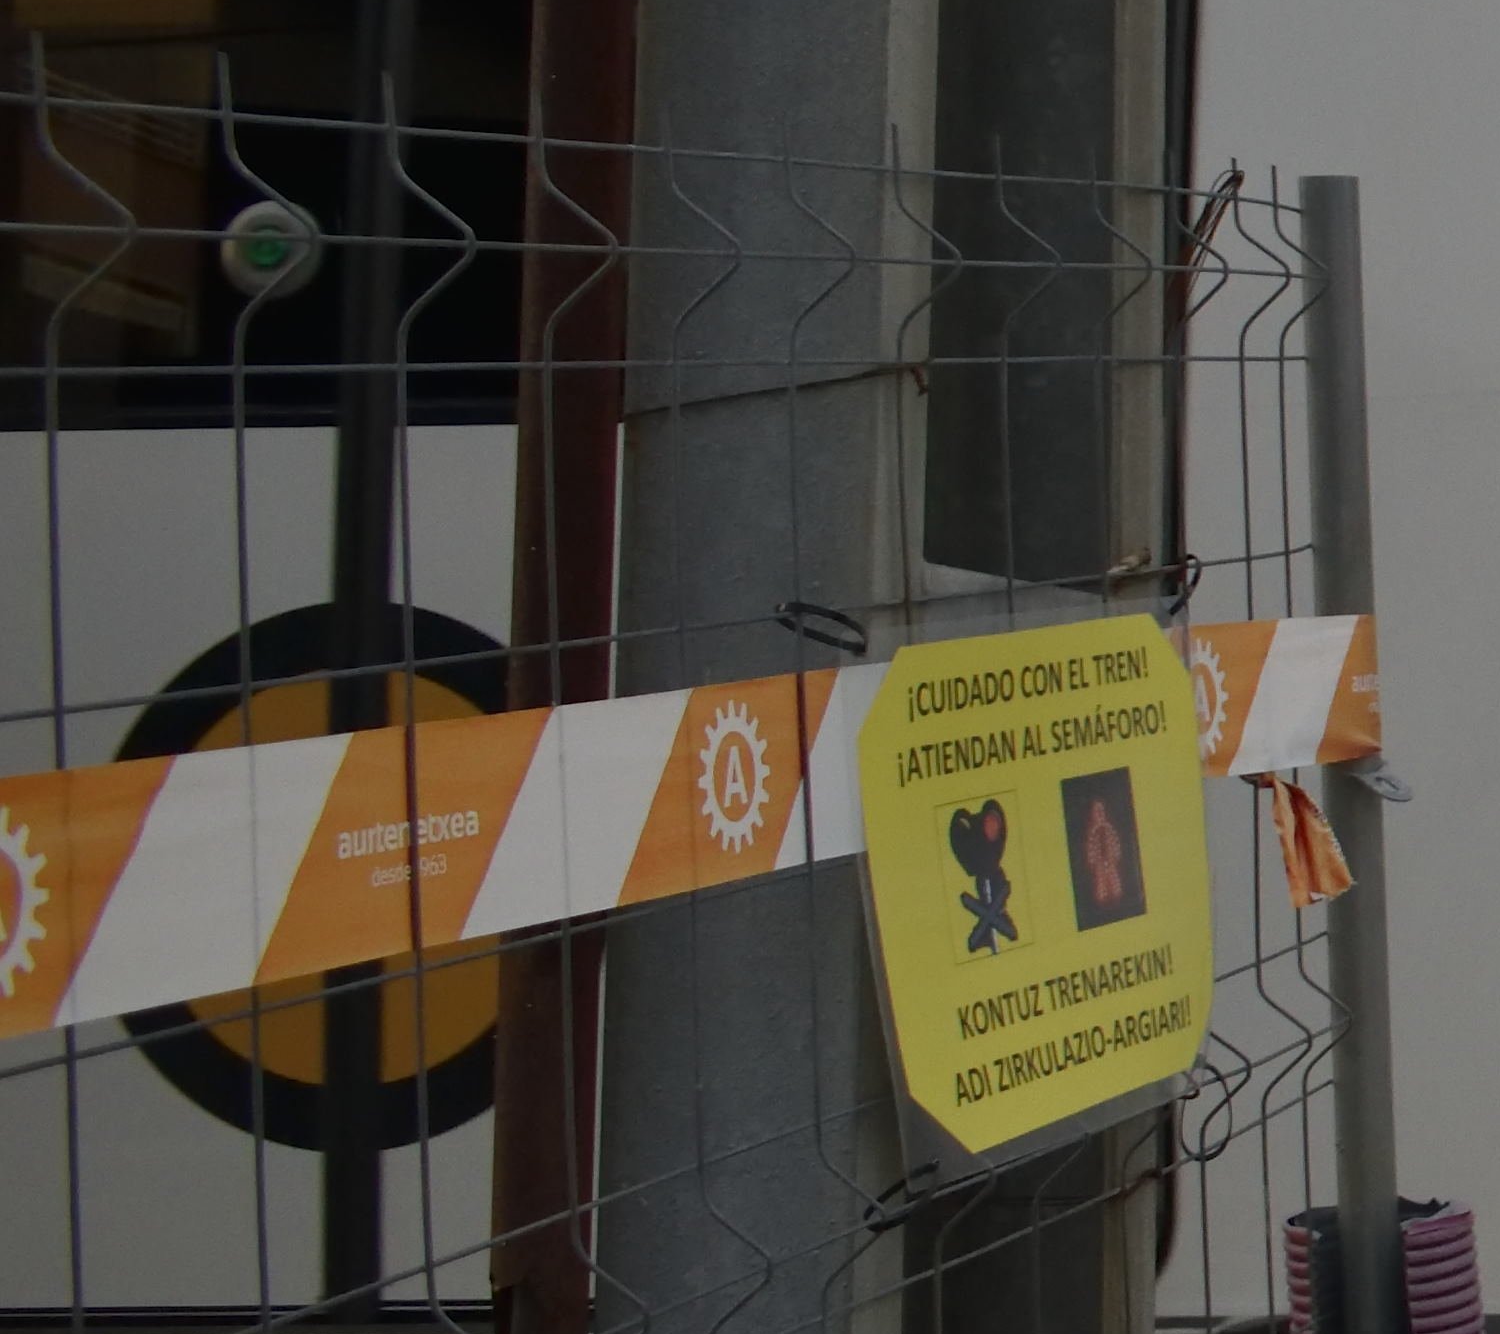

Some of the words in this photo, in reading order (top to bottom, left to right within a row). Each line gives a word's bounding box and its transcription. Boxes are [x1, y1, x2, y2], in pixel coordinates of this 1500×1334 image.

[908, 669, 1014, 722] ¡CUIDADO
[1020, 662, 1062, 698] CON
[1069, 658, 1089, 689] EL
[1092, 646, 1148, 685] TREN!
[724, 745, 747, 808] A
[898, 729, 1016, 787] ¡ATIENDAN
[1022, 724, 1047, 759] AL
[1050, 700, 1167, 752] SEMÁFORO!
[418, 854, 448, 877] 963
[957, 983, 1044, 1040] KONTUZ
[1044, 944, 1173, 1011] TRENAREKIN!
[956, 1064, 993, 1107] ADI
[993, 995, 1192, 1092] ZIRKULAZIO-ARGIARI!
